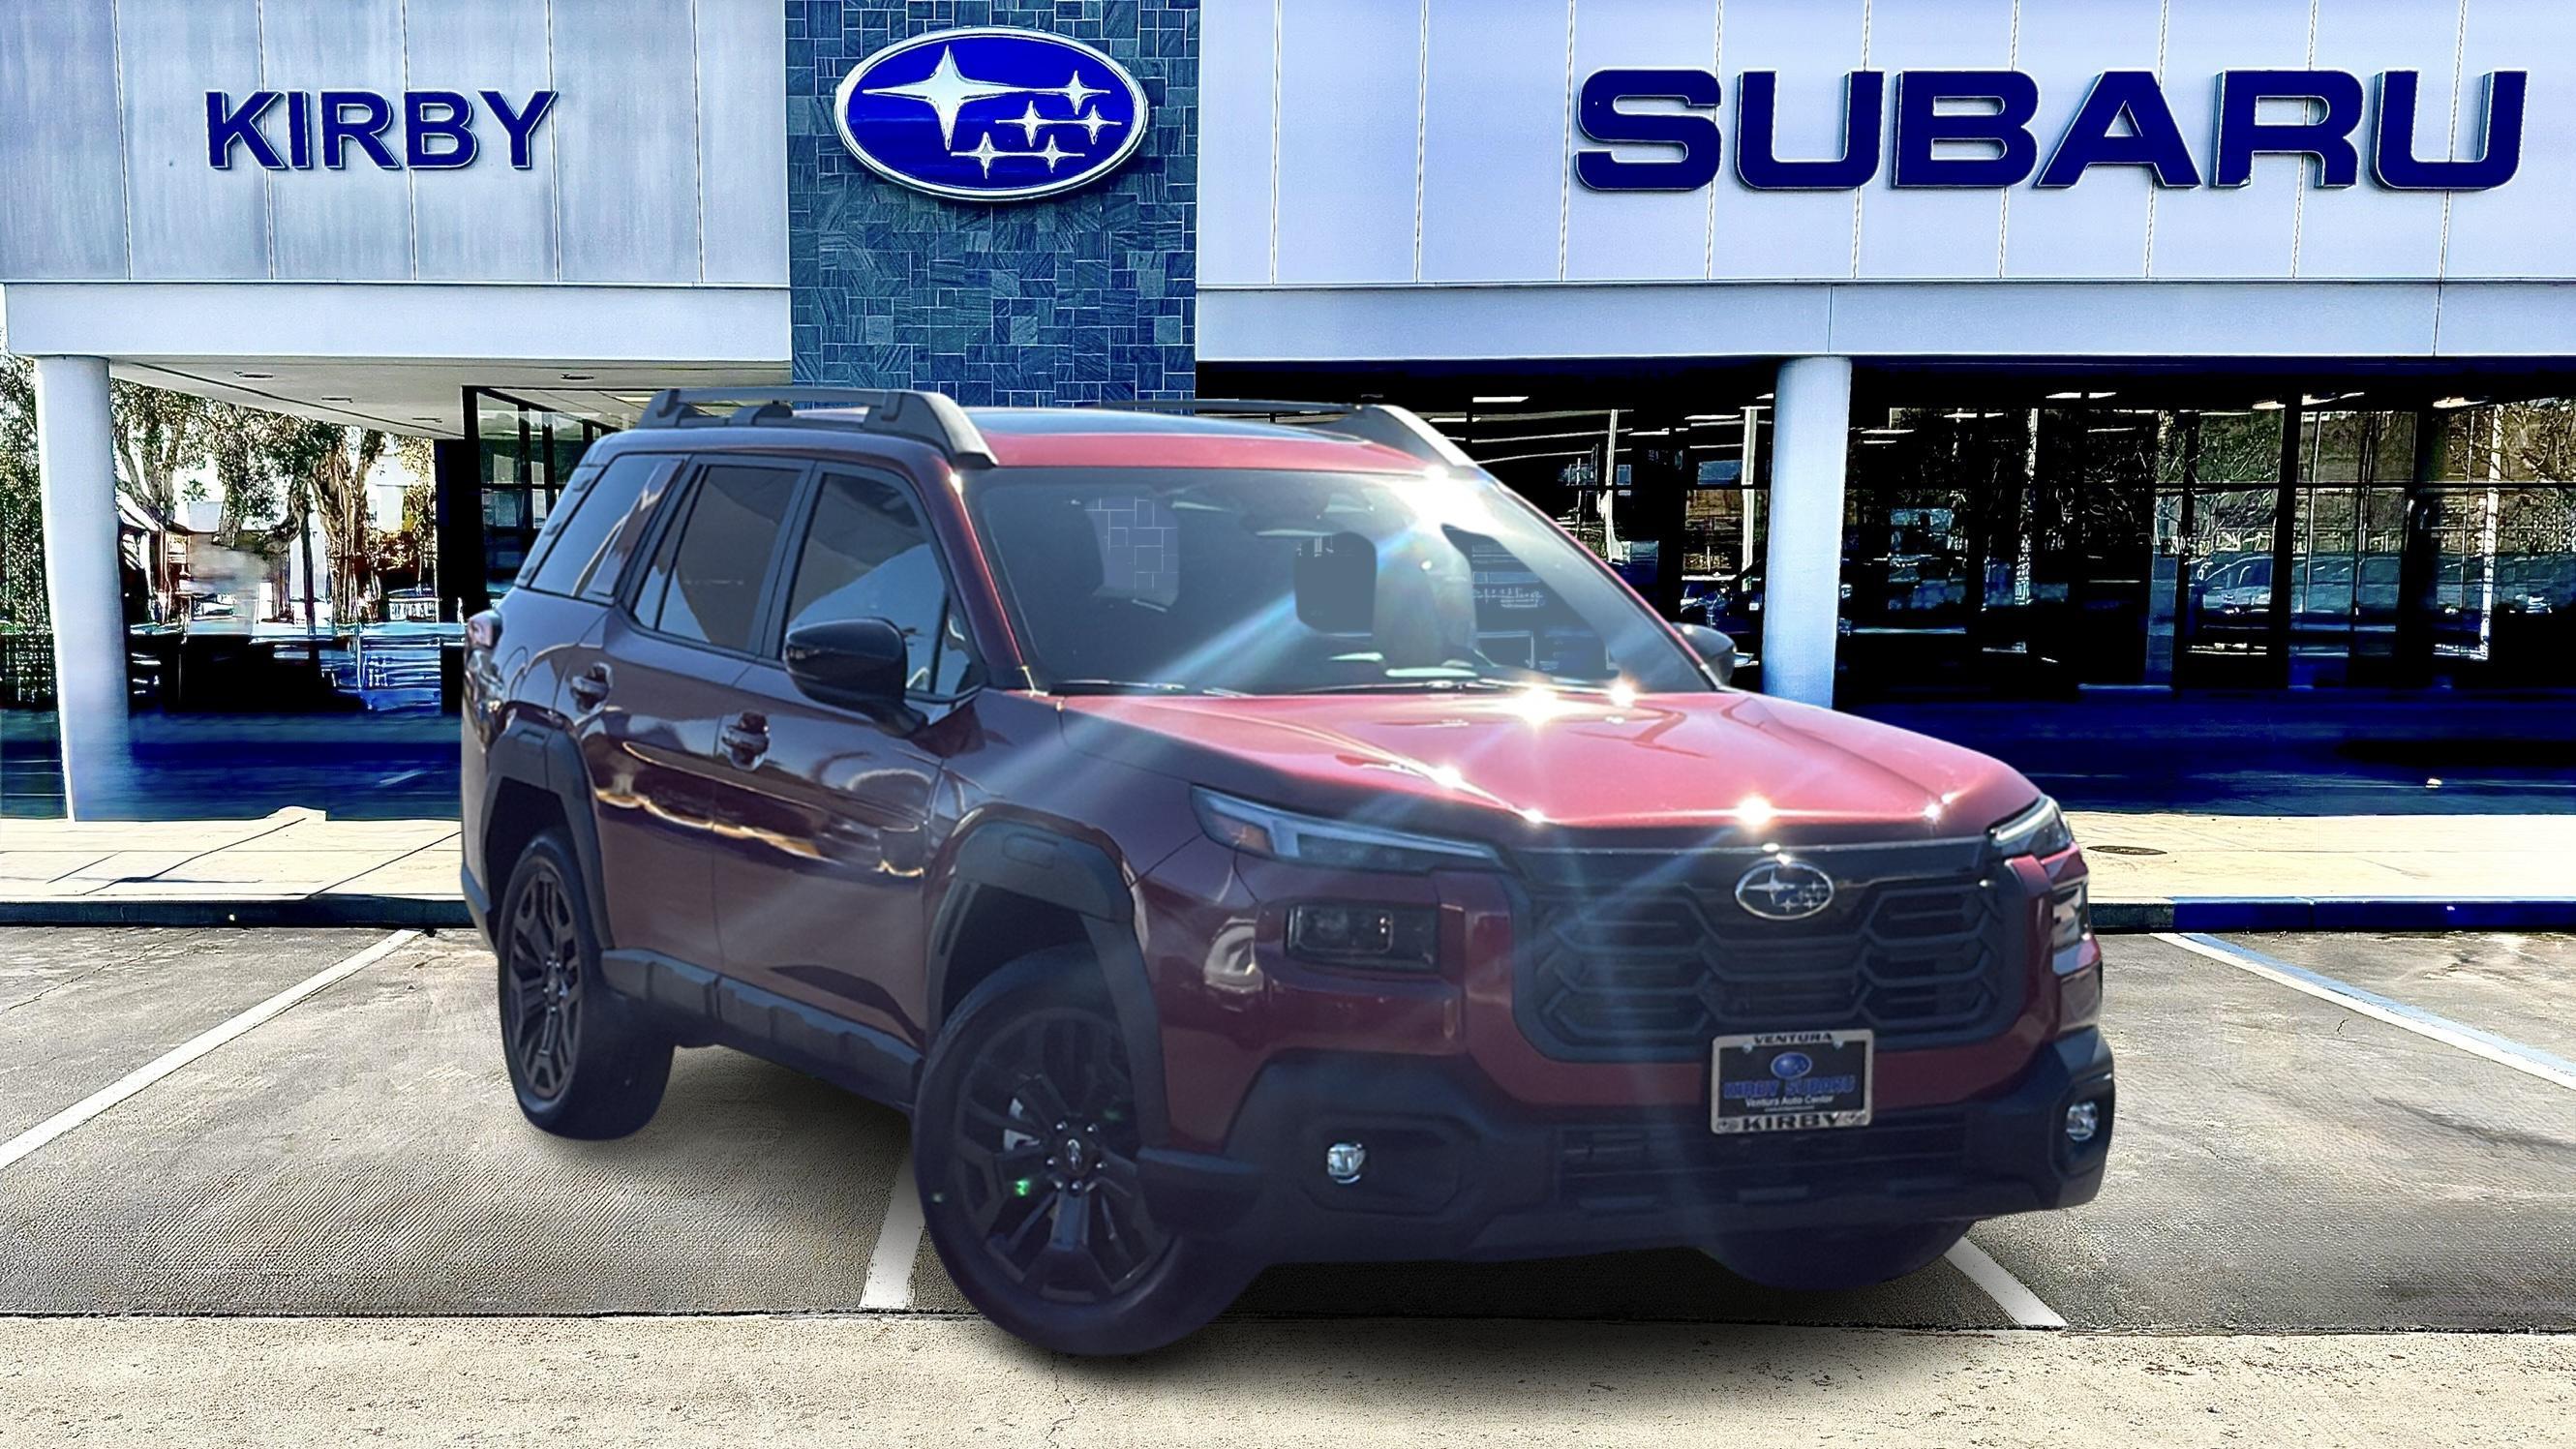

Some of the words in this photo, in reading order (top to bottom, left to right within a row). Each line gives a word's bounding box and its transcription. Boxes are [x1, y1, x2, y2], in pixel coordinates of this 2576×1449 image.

[204, 90, 559, 169] KIRBY
[1575, 69, 2529, 191] SUBARU
[1754, 1033, 1833, 1044] VENTURA
[1745, 1097, 1779, 1107] Ventura
[1781, 1096, 1803, 1105] Auto
[1804, 1094, 1834, 1104] Center
[1743, 1113, 1840, 1131] KIRBY
